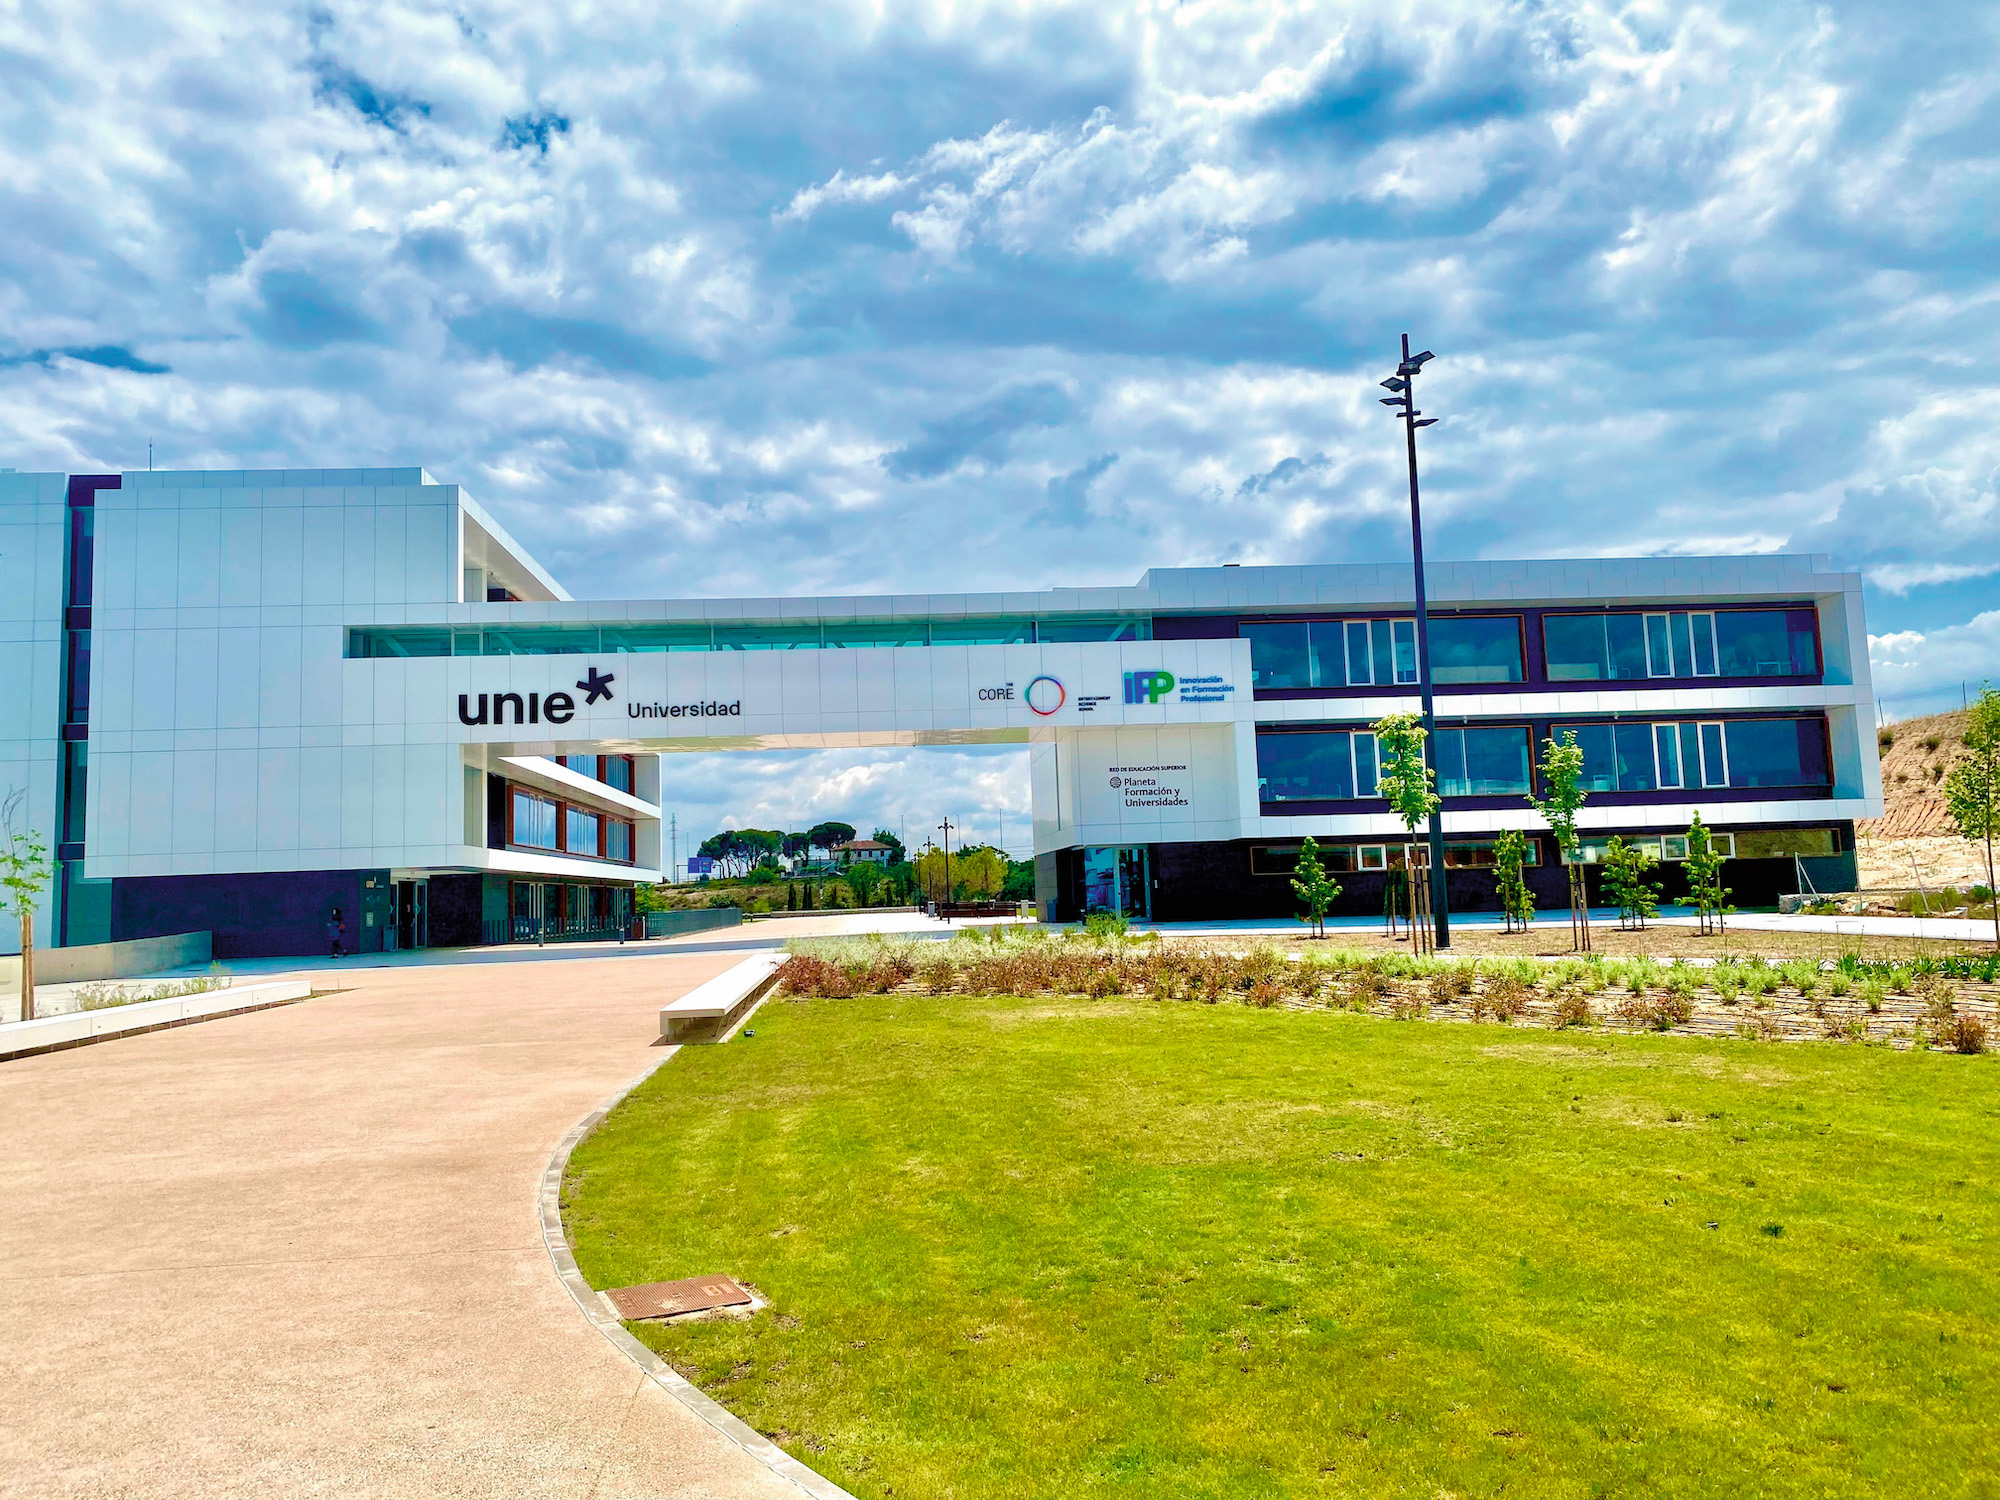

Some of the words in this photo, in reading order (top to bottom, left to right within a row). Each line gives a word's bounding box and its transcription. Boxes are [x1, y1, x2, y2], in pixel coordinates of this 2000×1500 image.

[1180, 676, 1223, 684] Innovación
[1192, 685, 1235, 693] Formación
[978, 688, 1015, 701] CORE
[1180, 694, 1225, 703] Profesional
[627, 700, 741, 719] Universidad
[1124, 777, 1156, 787] Planeta
[1125, 786, 1172, 796] Formación
[1174, 788, 1181, 798] y
[1125, 797, 1189, 807] Universidades
